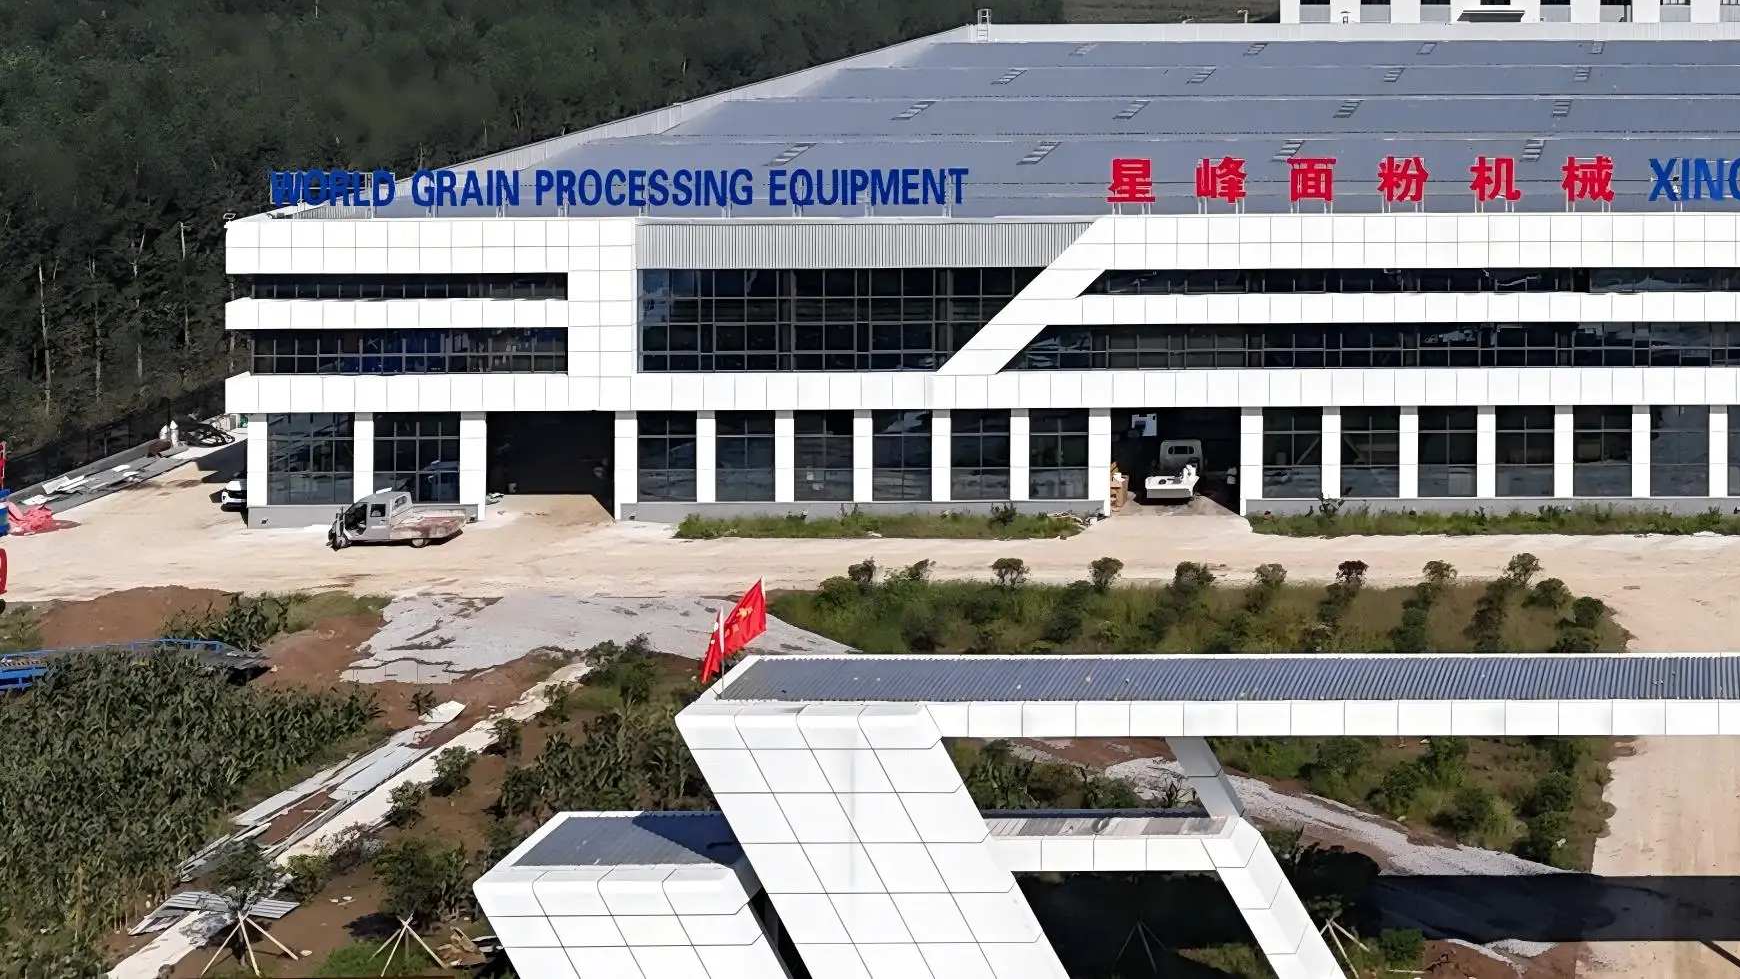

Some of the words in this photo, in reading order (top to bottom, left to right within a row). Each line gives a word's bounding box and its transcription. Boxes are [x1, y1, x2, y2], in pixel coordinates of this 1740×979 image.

[269, 169, 396, 207] WORLD
[411, 169, 519, 207] GRAIN
[536, 169, 753, 207] PROCESSING
[769, 168, 969, 207] EQUIPMENT
[1107, 156, 1615, 204] 星峰面粉机械
